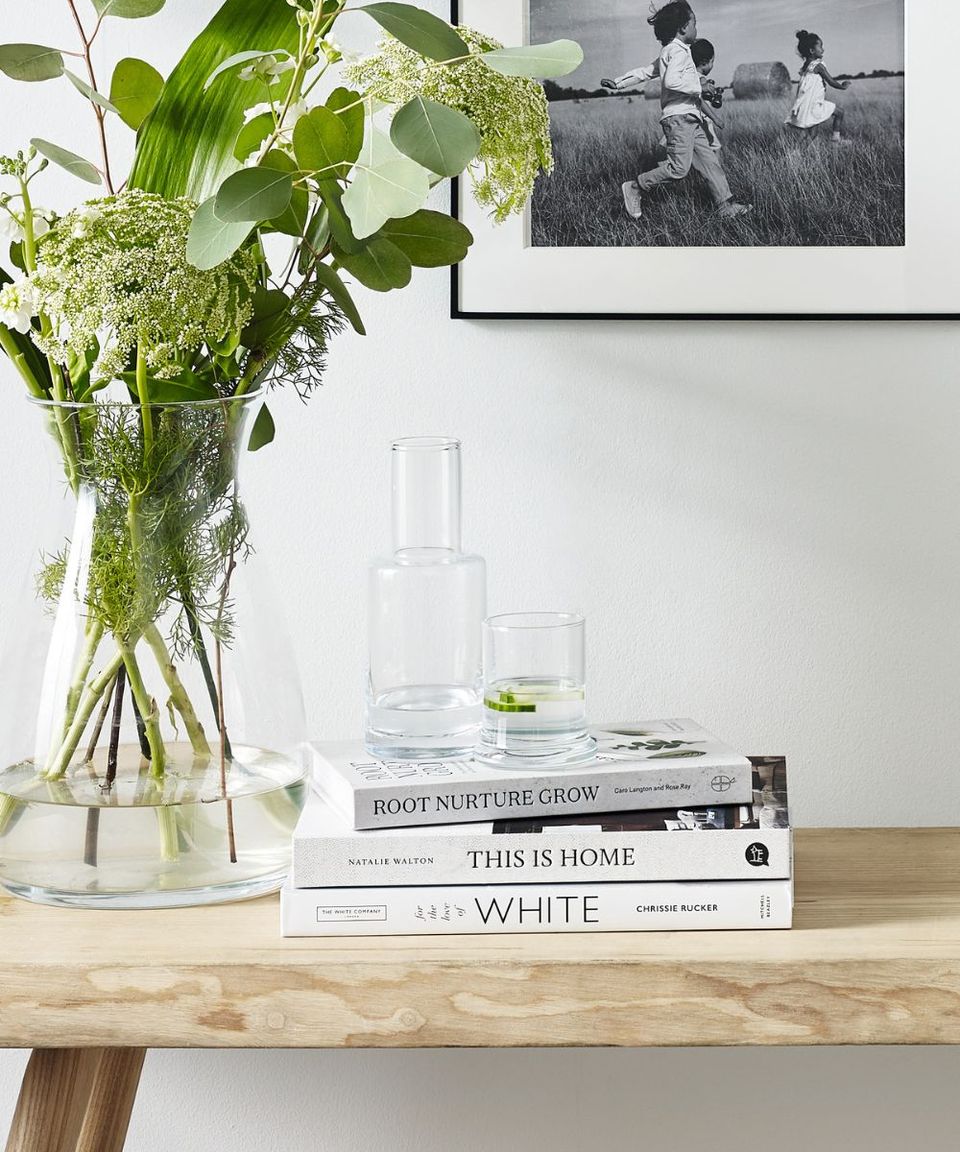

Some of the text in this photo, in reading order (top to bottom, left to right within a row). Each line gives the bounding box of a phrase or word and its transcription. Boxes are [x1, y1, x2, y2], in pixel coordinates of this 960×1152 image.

[628, 785, 652, 794] Langton
[653, 784, 664, 792] and
[665, 784, 679, 792] Rose
[680, 782, 691, 792] Ray
[373, 786, 600, 816] ROOT NURTURE GROW
[348, 857, 434, 866] NATALIE WALTON
[467, 847, 636, 868] THIS IS HOME
[414, 905, 427, 922] for
[428, 904, 438, 920] the
[441, 902, 451, 922] love
[454, 904, 466, 917] of
[475, 896, 599, 924] WHITE
[636, 903, 719, 913] CHRISSIE RUCKER
